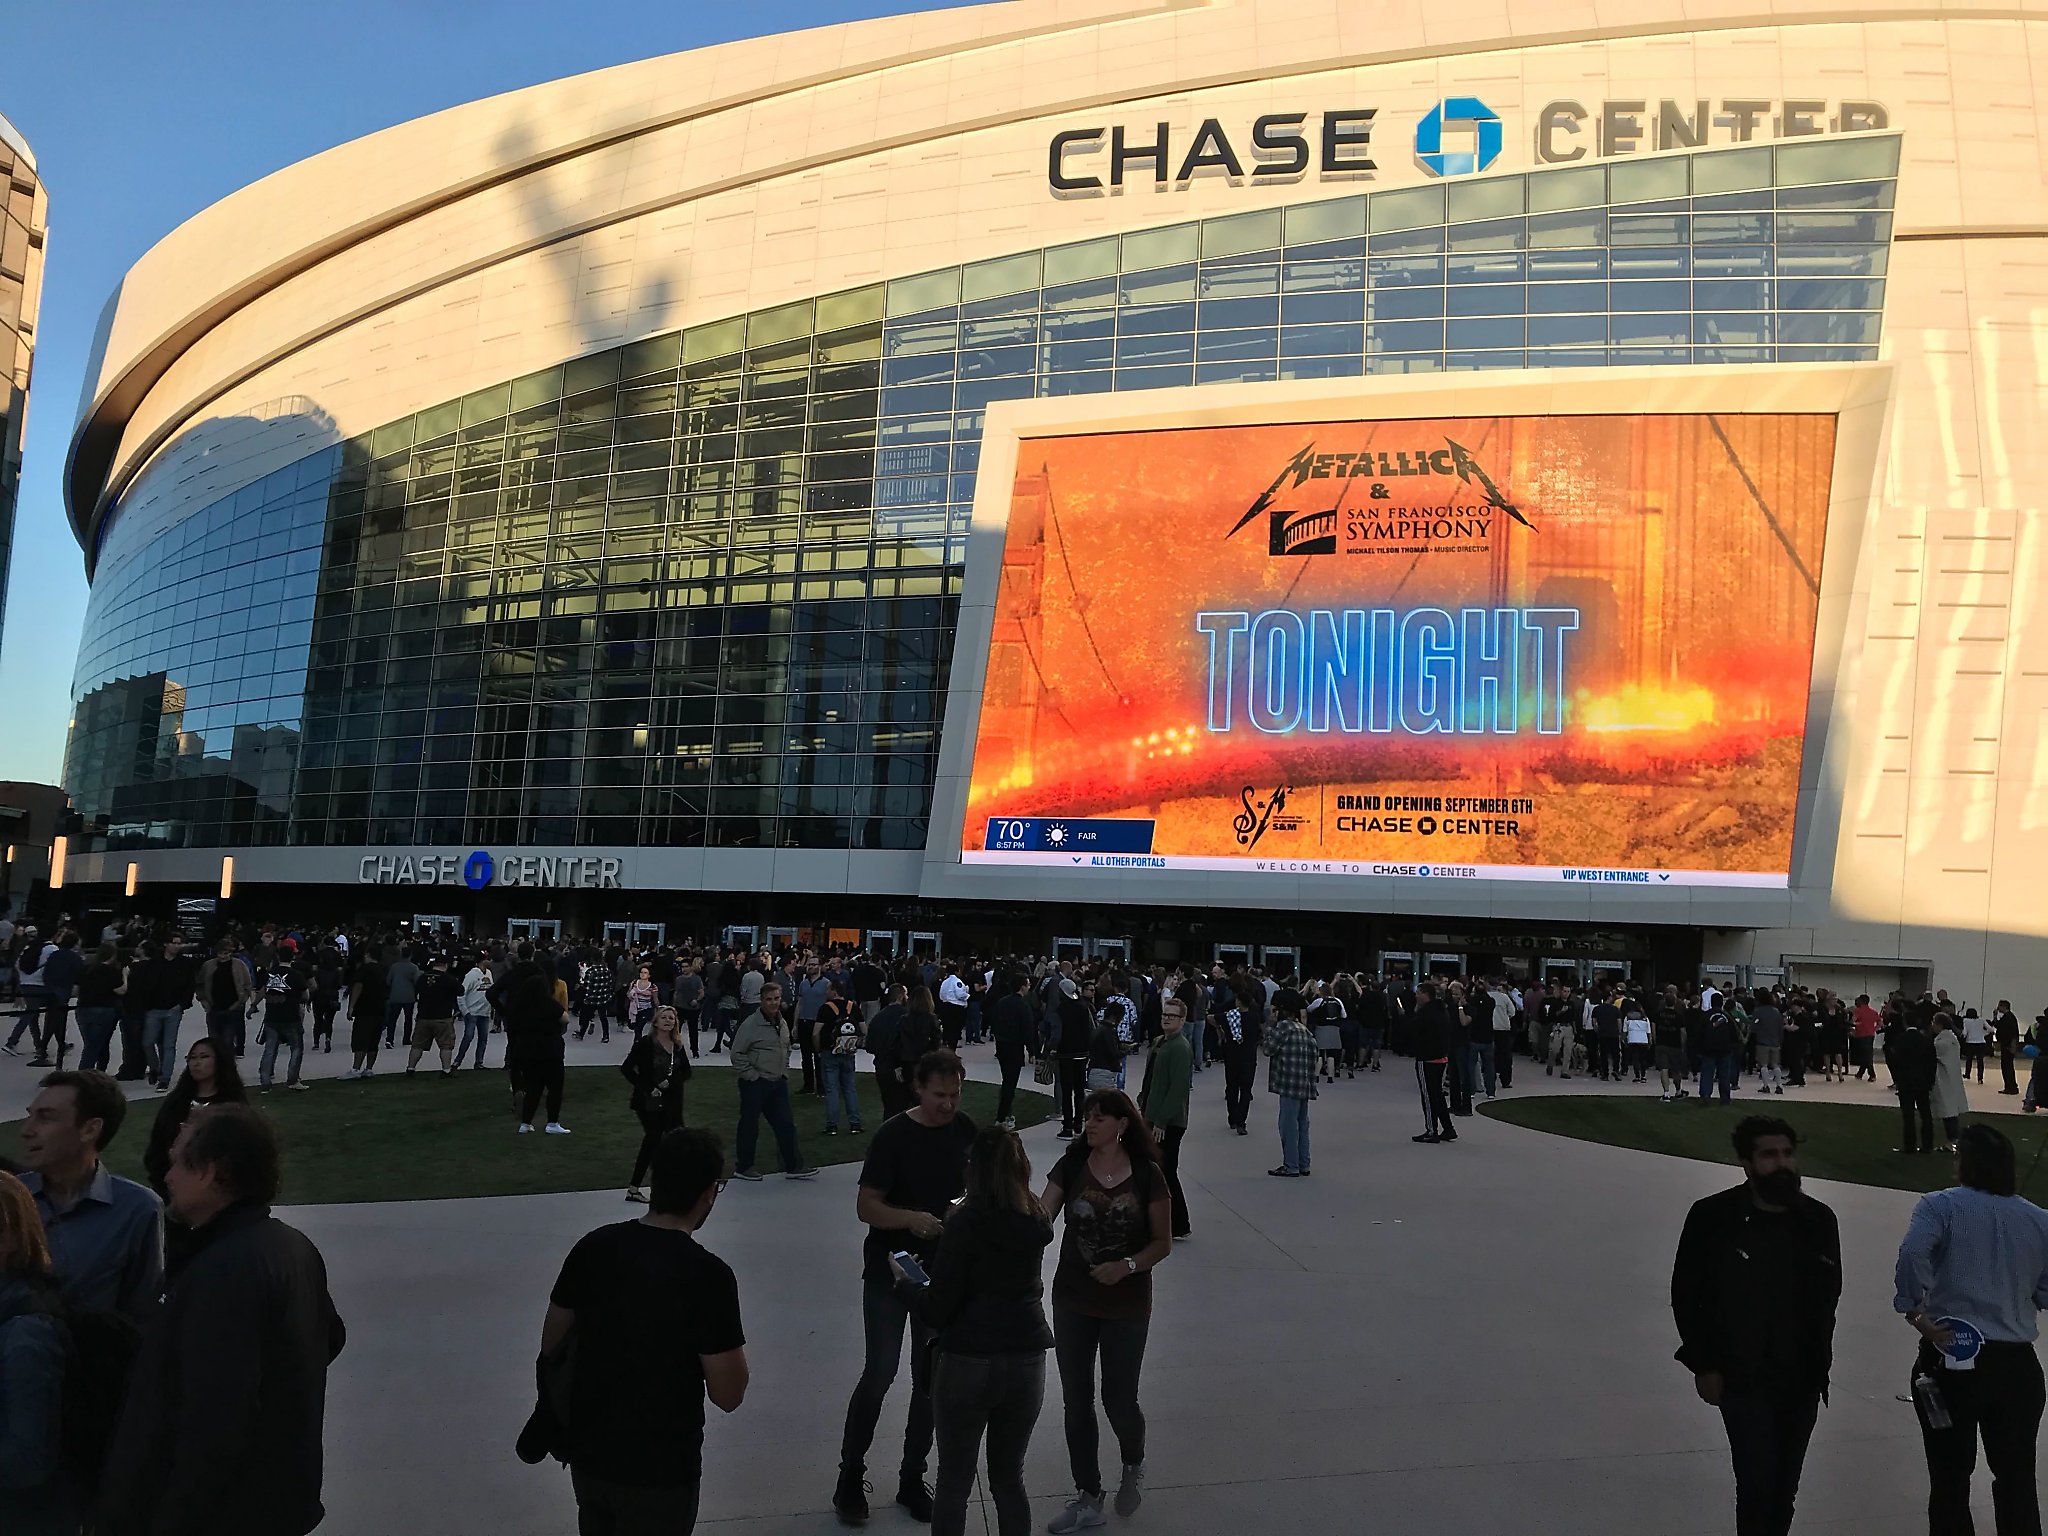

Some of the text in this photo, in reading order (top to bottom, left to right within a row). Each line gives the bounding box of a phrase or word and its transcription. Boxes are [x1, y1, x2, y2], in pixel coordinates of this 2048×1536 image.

[1049, 108, 1378, 190] CHASE
[1225, 436, 1539, 539] METALLICA
[1370, 483, 1390, 499] &
[1347, 505, 1491, 519] SAN FRANCISCO
[1346, 520, 1492, 541] SYMPHONY
[1400, 546, 1429, 554] THOMAS
[1456, 545, 1490, 553] DIRECTOR
[1196, 607, 1580, 736] TONIGHT
[1337, 795, 1533, 814] GRAND OPENING SEPTEMBER 6TH
[1272, 823, 1297, 831] S&M
[1337, 816, 1519, 836] CHASE CENTER
[1078, 832, 1097, 840] FAIR
[996, 841, 1025, 849] 6:57 PM
[1091, 856, 1166, 867] ALL OTHER PORTALS
[358, 855, 623, 889] CHASE CENTER
[1256, 862, 1476, 877] WELCOME TO CHASE CENTER
[1562, 869, 1650, 882] VIP WEST ENTRANCE
